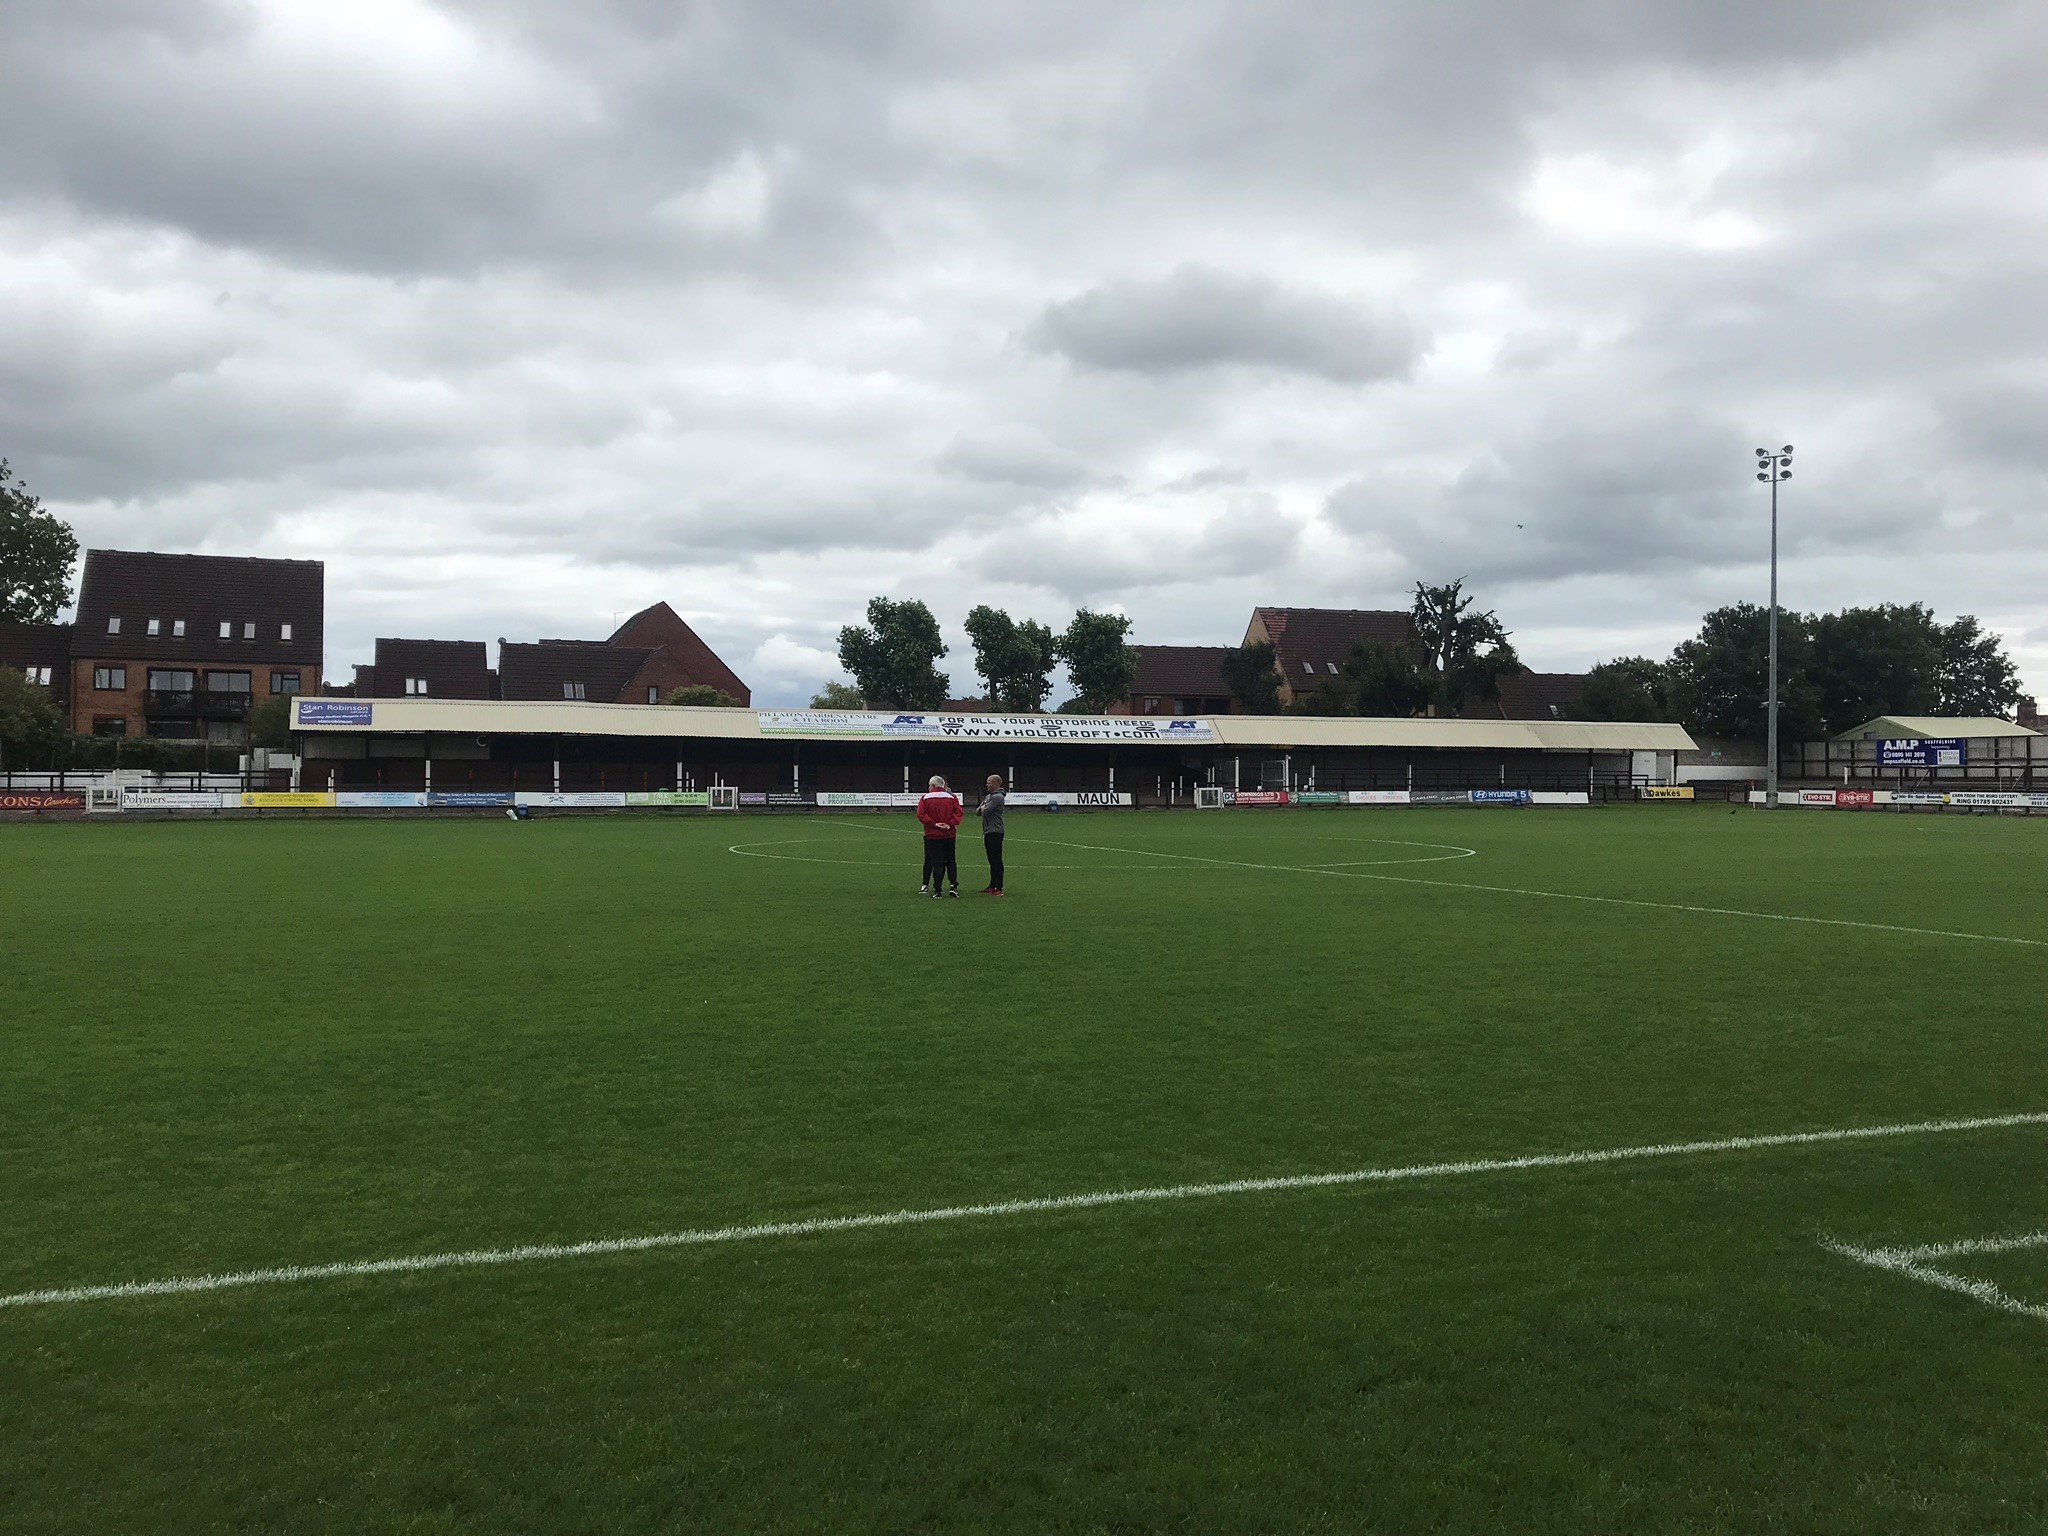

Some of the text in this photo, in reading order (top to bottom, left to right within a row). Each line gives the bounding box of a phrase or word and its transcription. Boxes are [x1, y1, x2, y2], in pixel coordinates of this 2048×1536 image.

[1041, 718, 1110, 726] MOTORING
[1649, 789, 1681, 797] Dawkes
[123, 794, 166, 807] Polymers
[1077, 793, 1120, 804] MAUN
